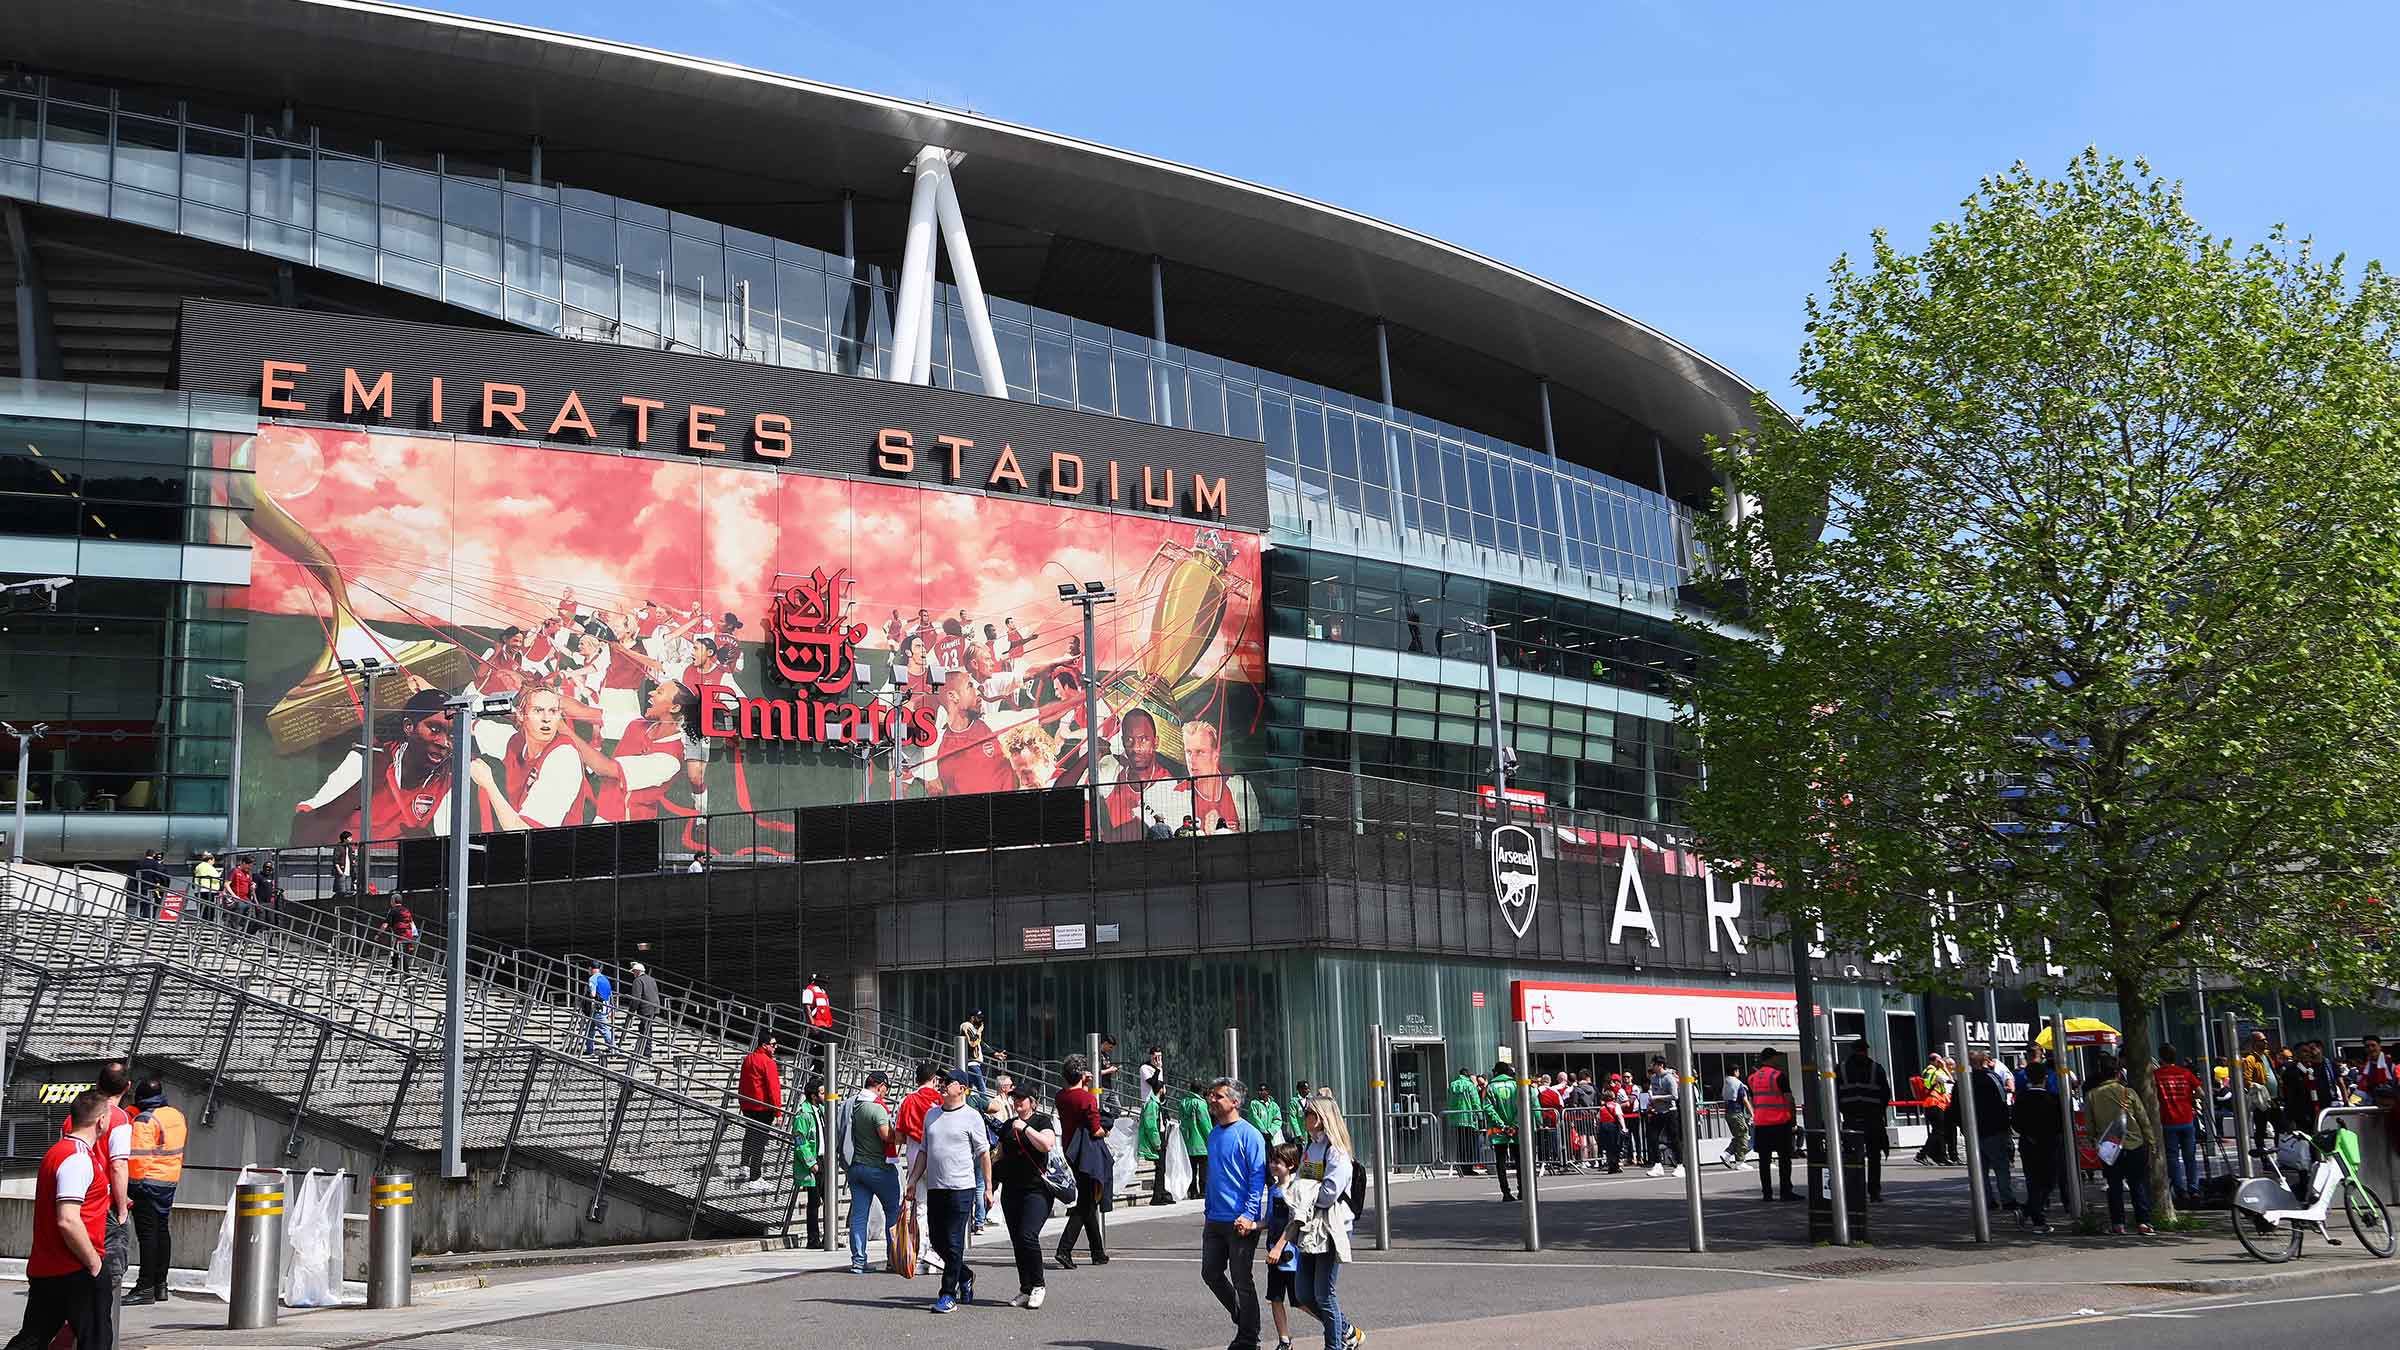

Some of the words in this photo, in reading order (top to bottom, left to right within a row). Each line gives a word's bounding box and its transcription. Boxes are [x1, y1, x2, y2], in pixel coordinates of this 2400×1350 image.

[261, 360, 794, 459] EMIRATES
[877, 427, 1227, 517] STADIUM
[942, 649, 959, 671] 23
[695, 684, 938, 748] Emirates
[1498, 847, 1533, 867] Arsenal
[1406, 1014, 1425, 1024] MEDIA
[1737, 1005, 1758, 1027] BOX
[1759, 1006, 1792, 1028] OFFICE
[1399, 1025, 1433, 1034] ENTRANCE
